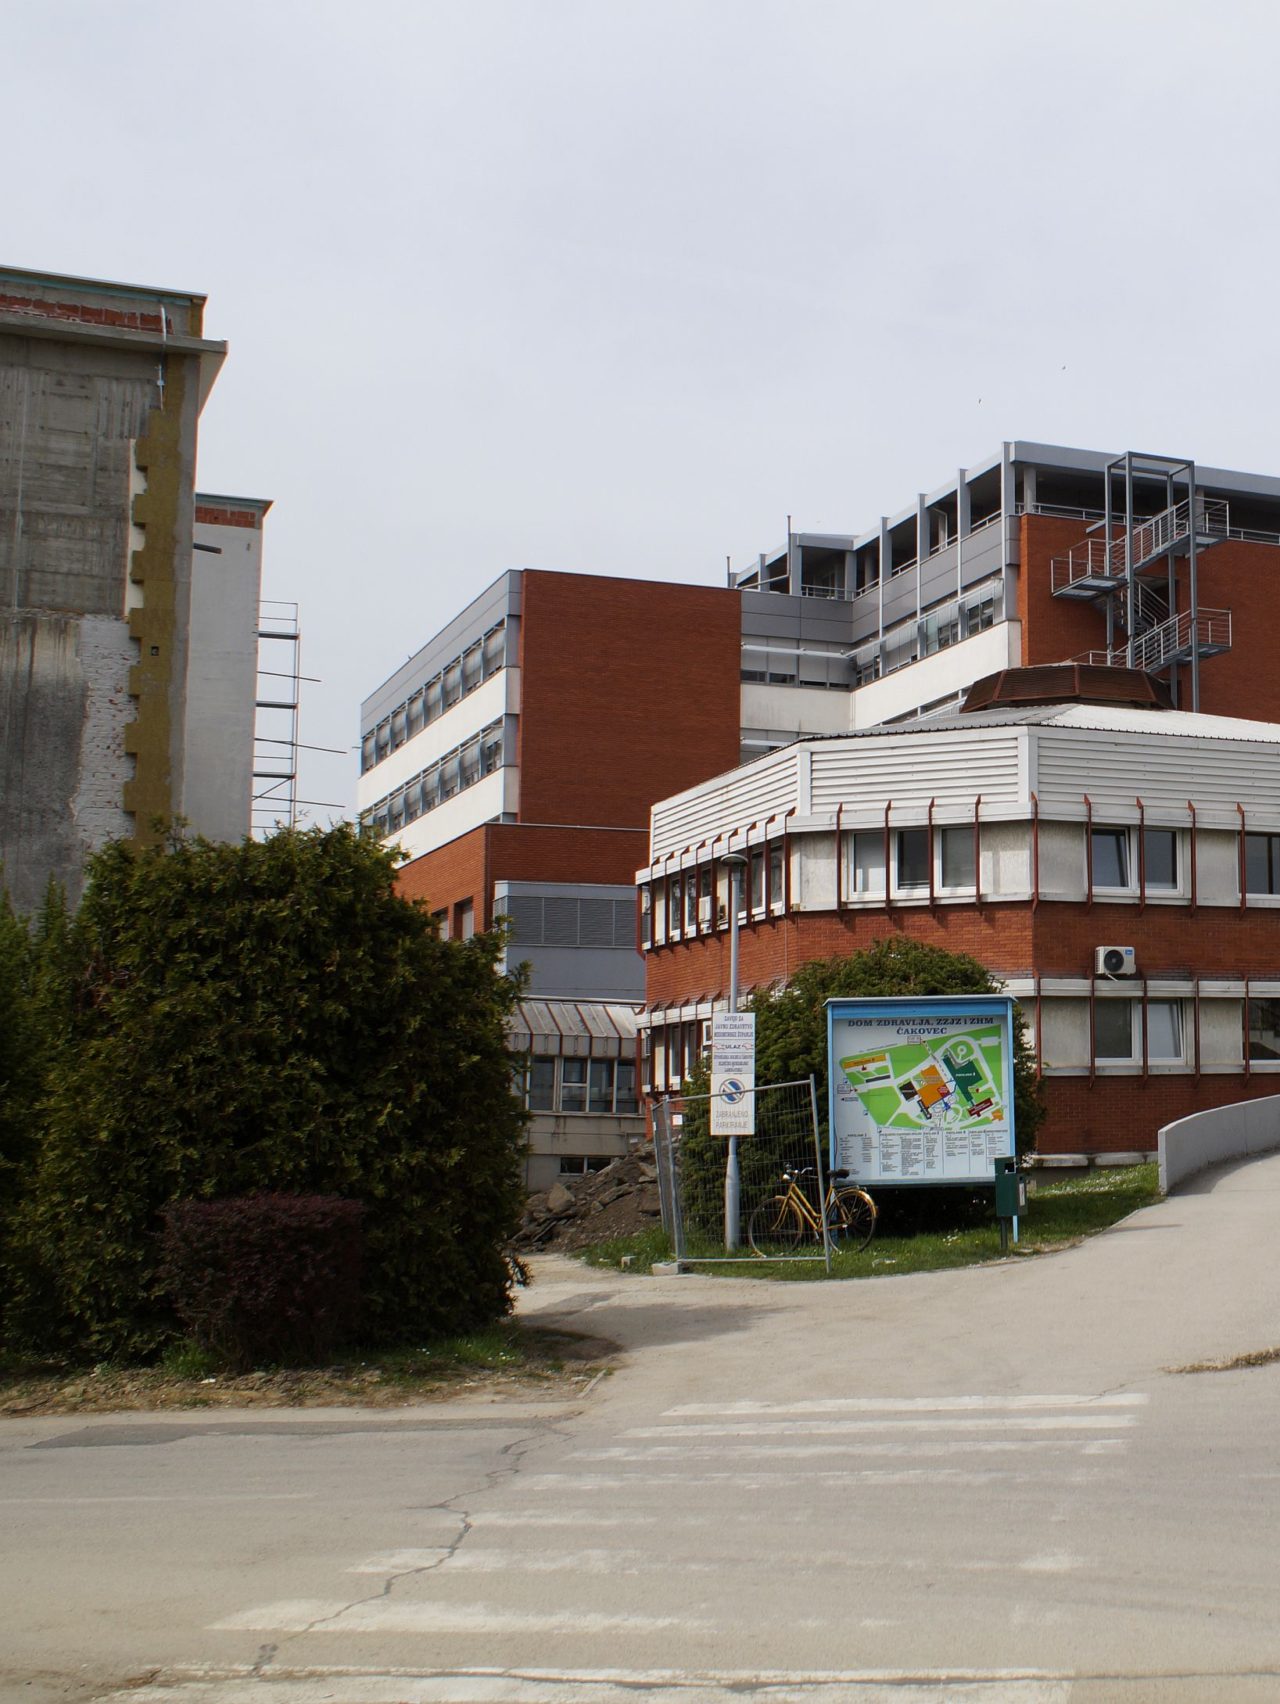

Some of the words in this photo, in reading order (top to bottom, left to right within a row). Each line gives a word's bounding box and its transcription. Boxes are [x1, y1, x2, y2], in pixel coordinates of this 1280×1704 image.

[848, 1019, 873, 1027] DOM
[936, 1018, 962, 1026] ZZJZ
[969, 1017, 994, 1025] ZHM
